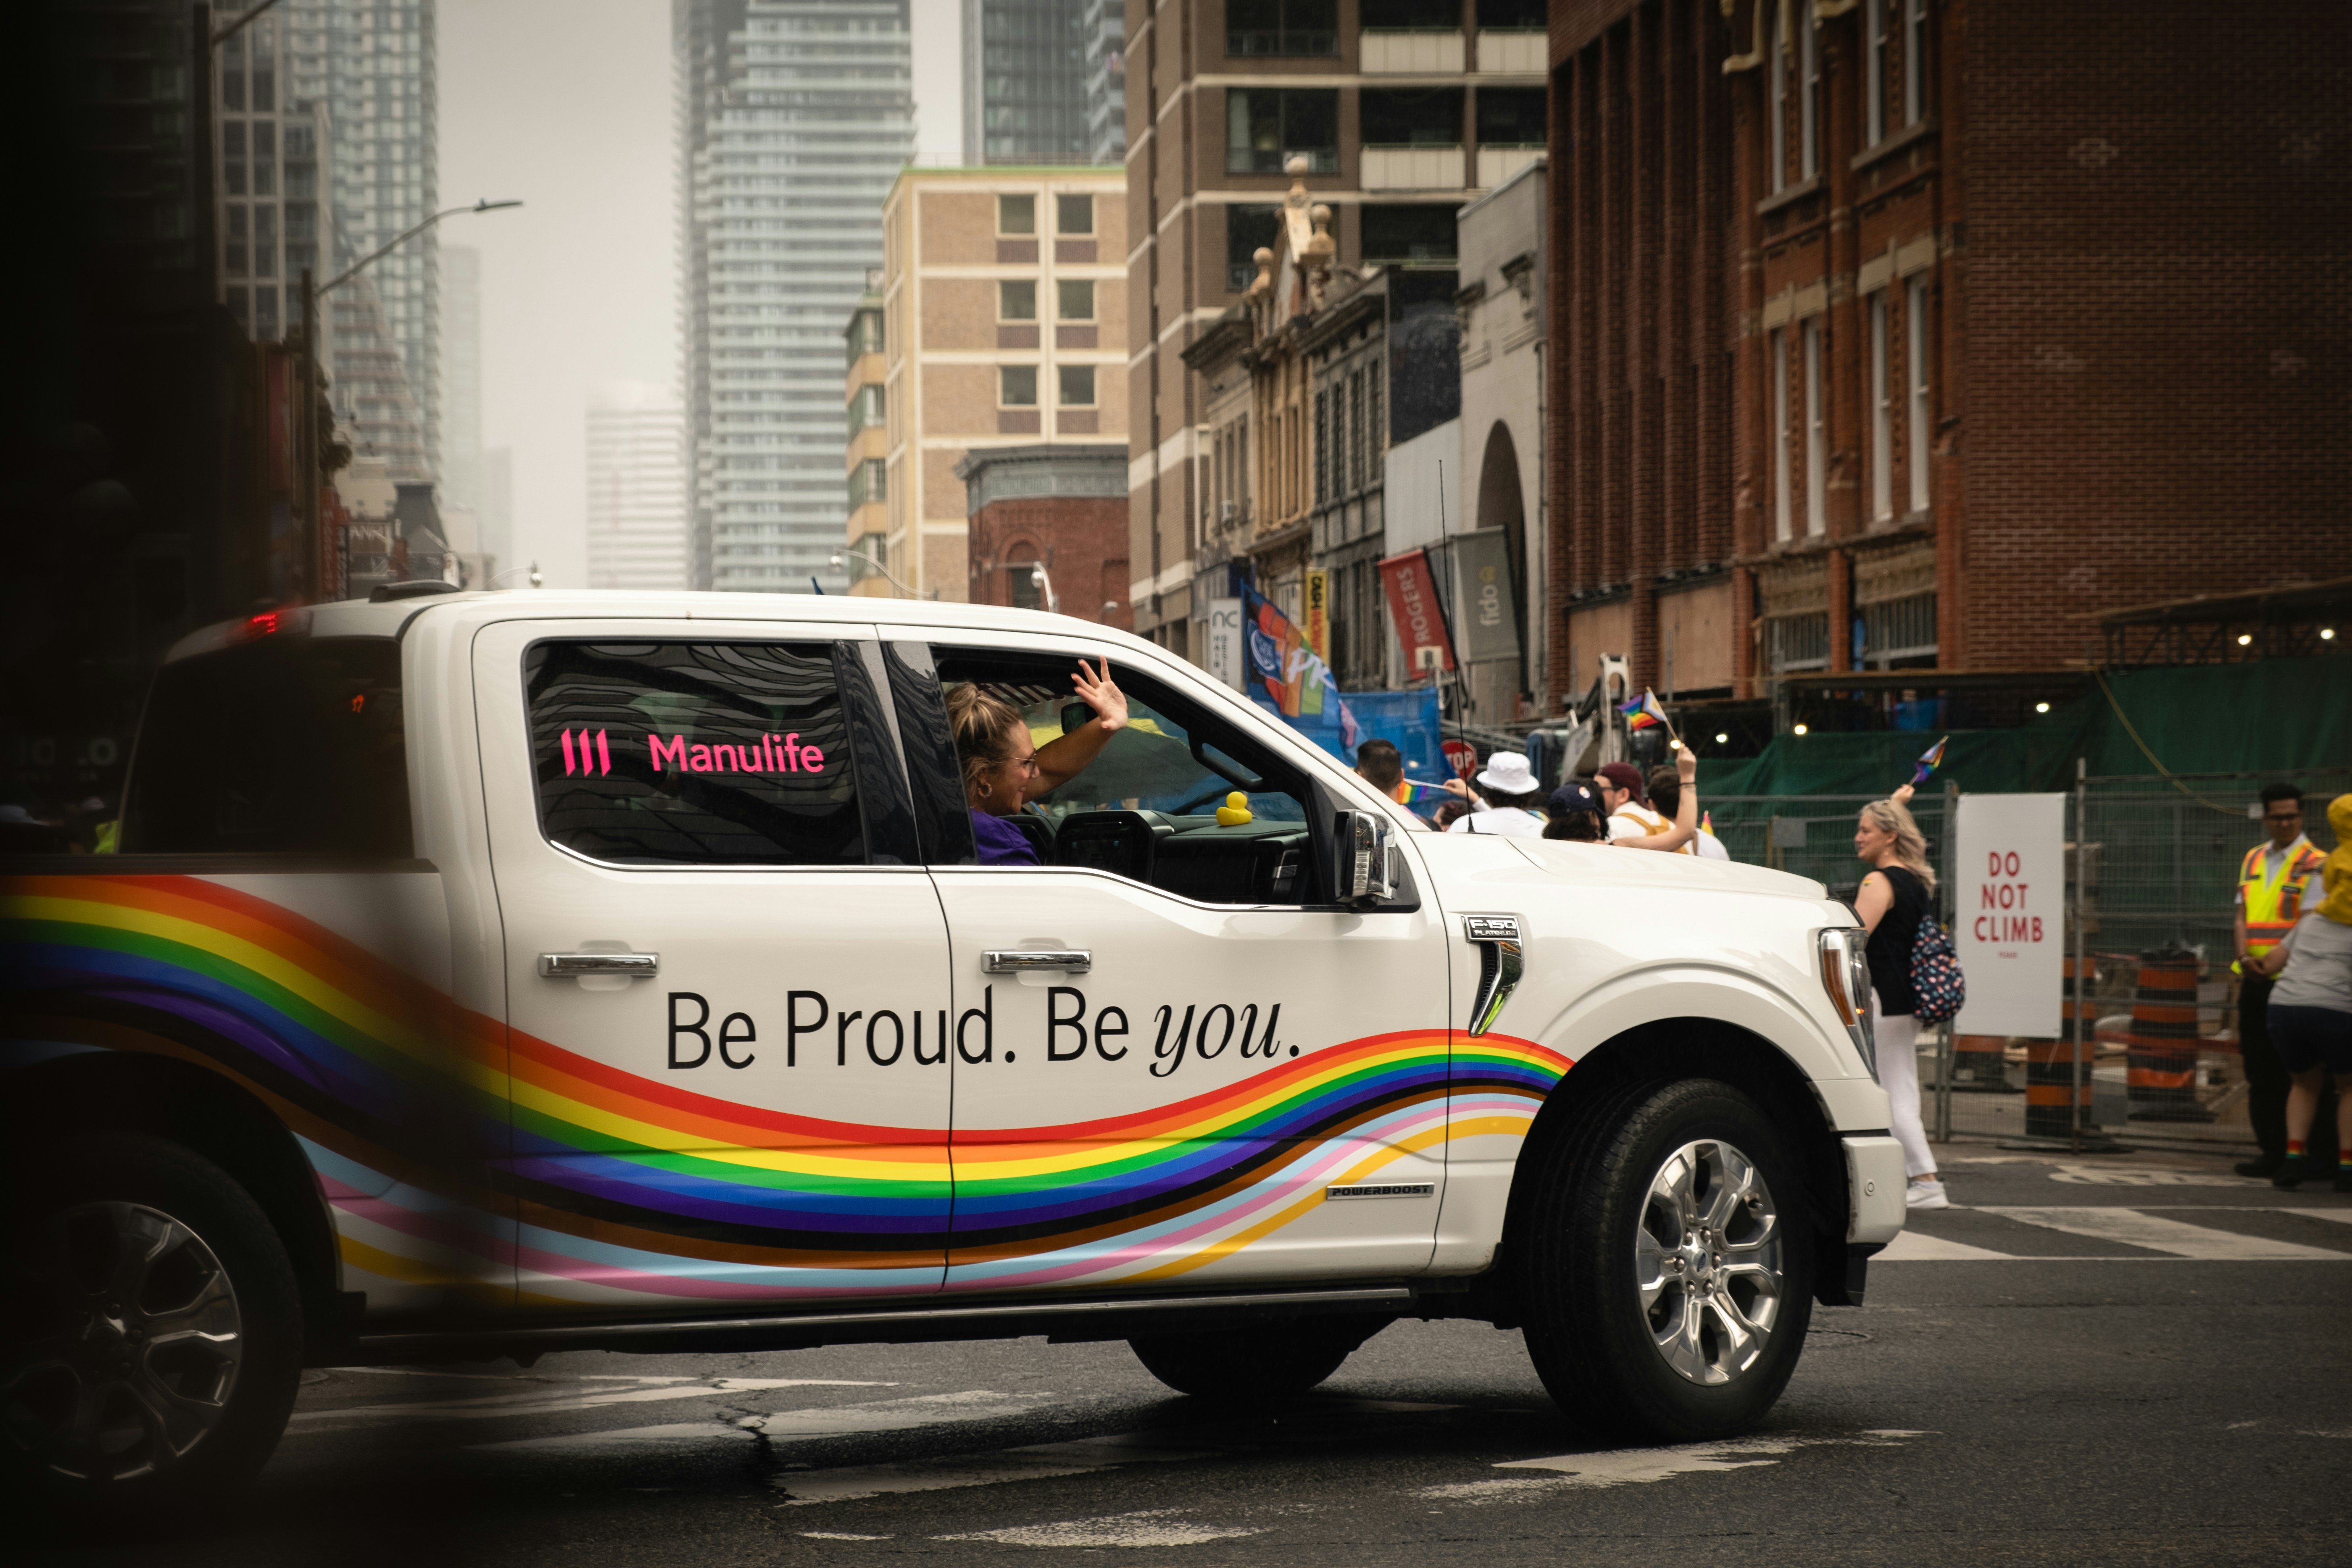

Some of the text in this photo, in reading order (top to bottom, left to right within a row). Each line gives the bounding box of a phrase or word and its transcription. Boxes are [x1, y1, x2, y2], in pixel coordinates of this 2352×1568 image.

[1312, 577, 1322, 608] CASH
[1397, 566, 1432, 644] ROGERS
[1478, 584, 1501, 626] fido
[648, 733, 824, 773] Manulife
[1445, 751, 1474, 770] TOP
[1989, 851, 2021, 877] DO
[1982, 883, 2029, 910] NOT
[1469, 919, 1517, 929] F-150
[1975, 916, 2044, 943] CLIMB
[668, 984, 1299, 1078] Be Proud. Be you.
[1332, 1185, 1430, 1196] POWERBOOST
